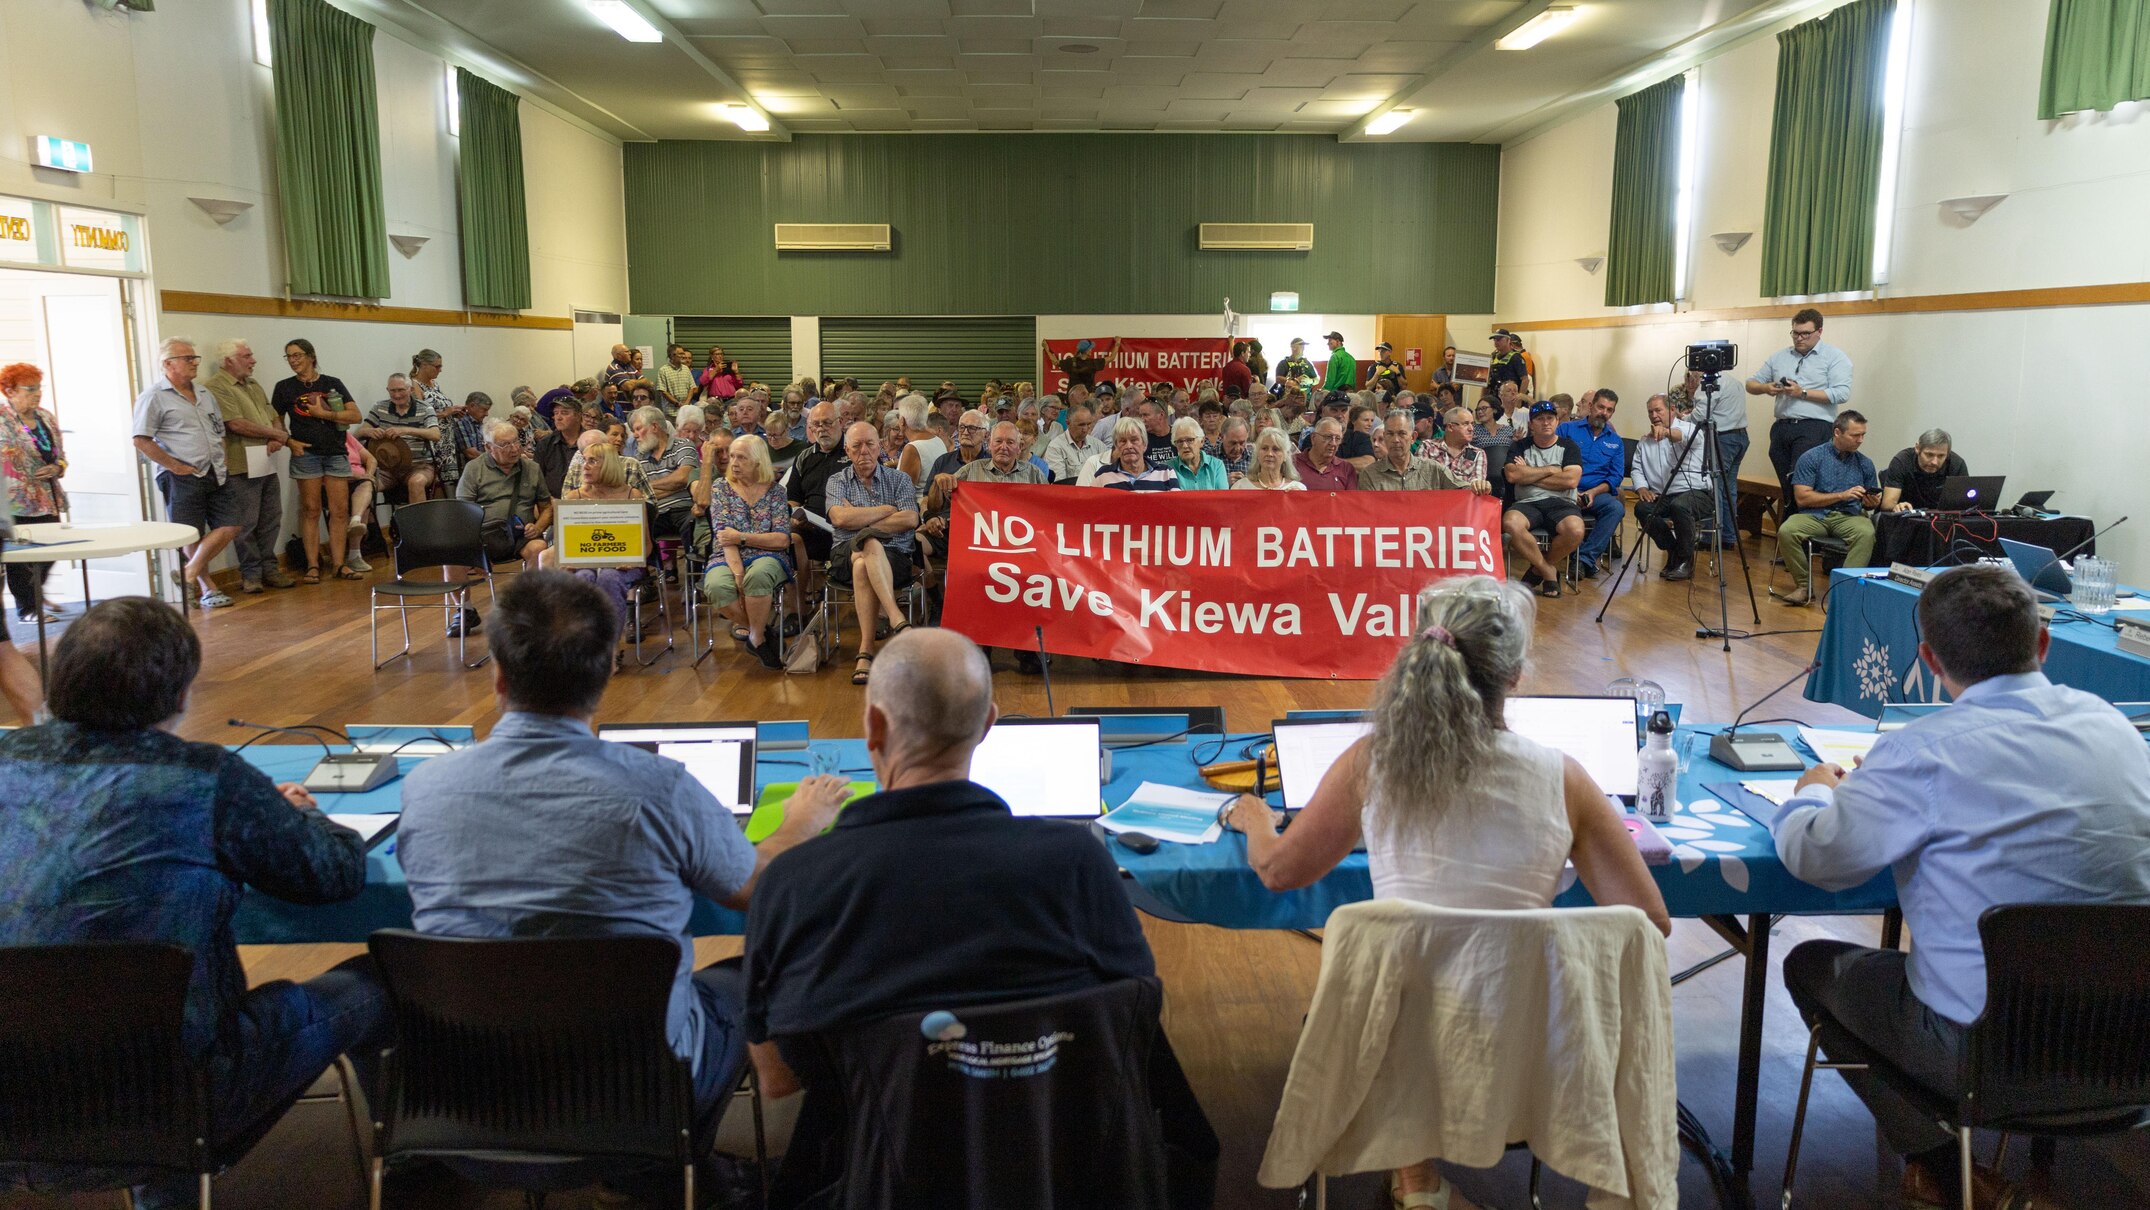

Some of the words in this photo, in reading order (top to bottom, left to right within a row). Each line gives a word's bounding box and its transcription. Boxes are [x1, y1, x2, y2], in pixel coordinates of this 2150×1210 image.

[973, 510, 1035, 547] NO
[1056, 522, 1232, 567] LITHIUM
[1256, 526, 1495, 572] BATTERIES
[984, 562, 1114, 617] Save
[1140, 588, 1302, 635] Kiewa
[980, 1041, 1036, 1055] Finance
